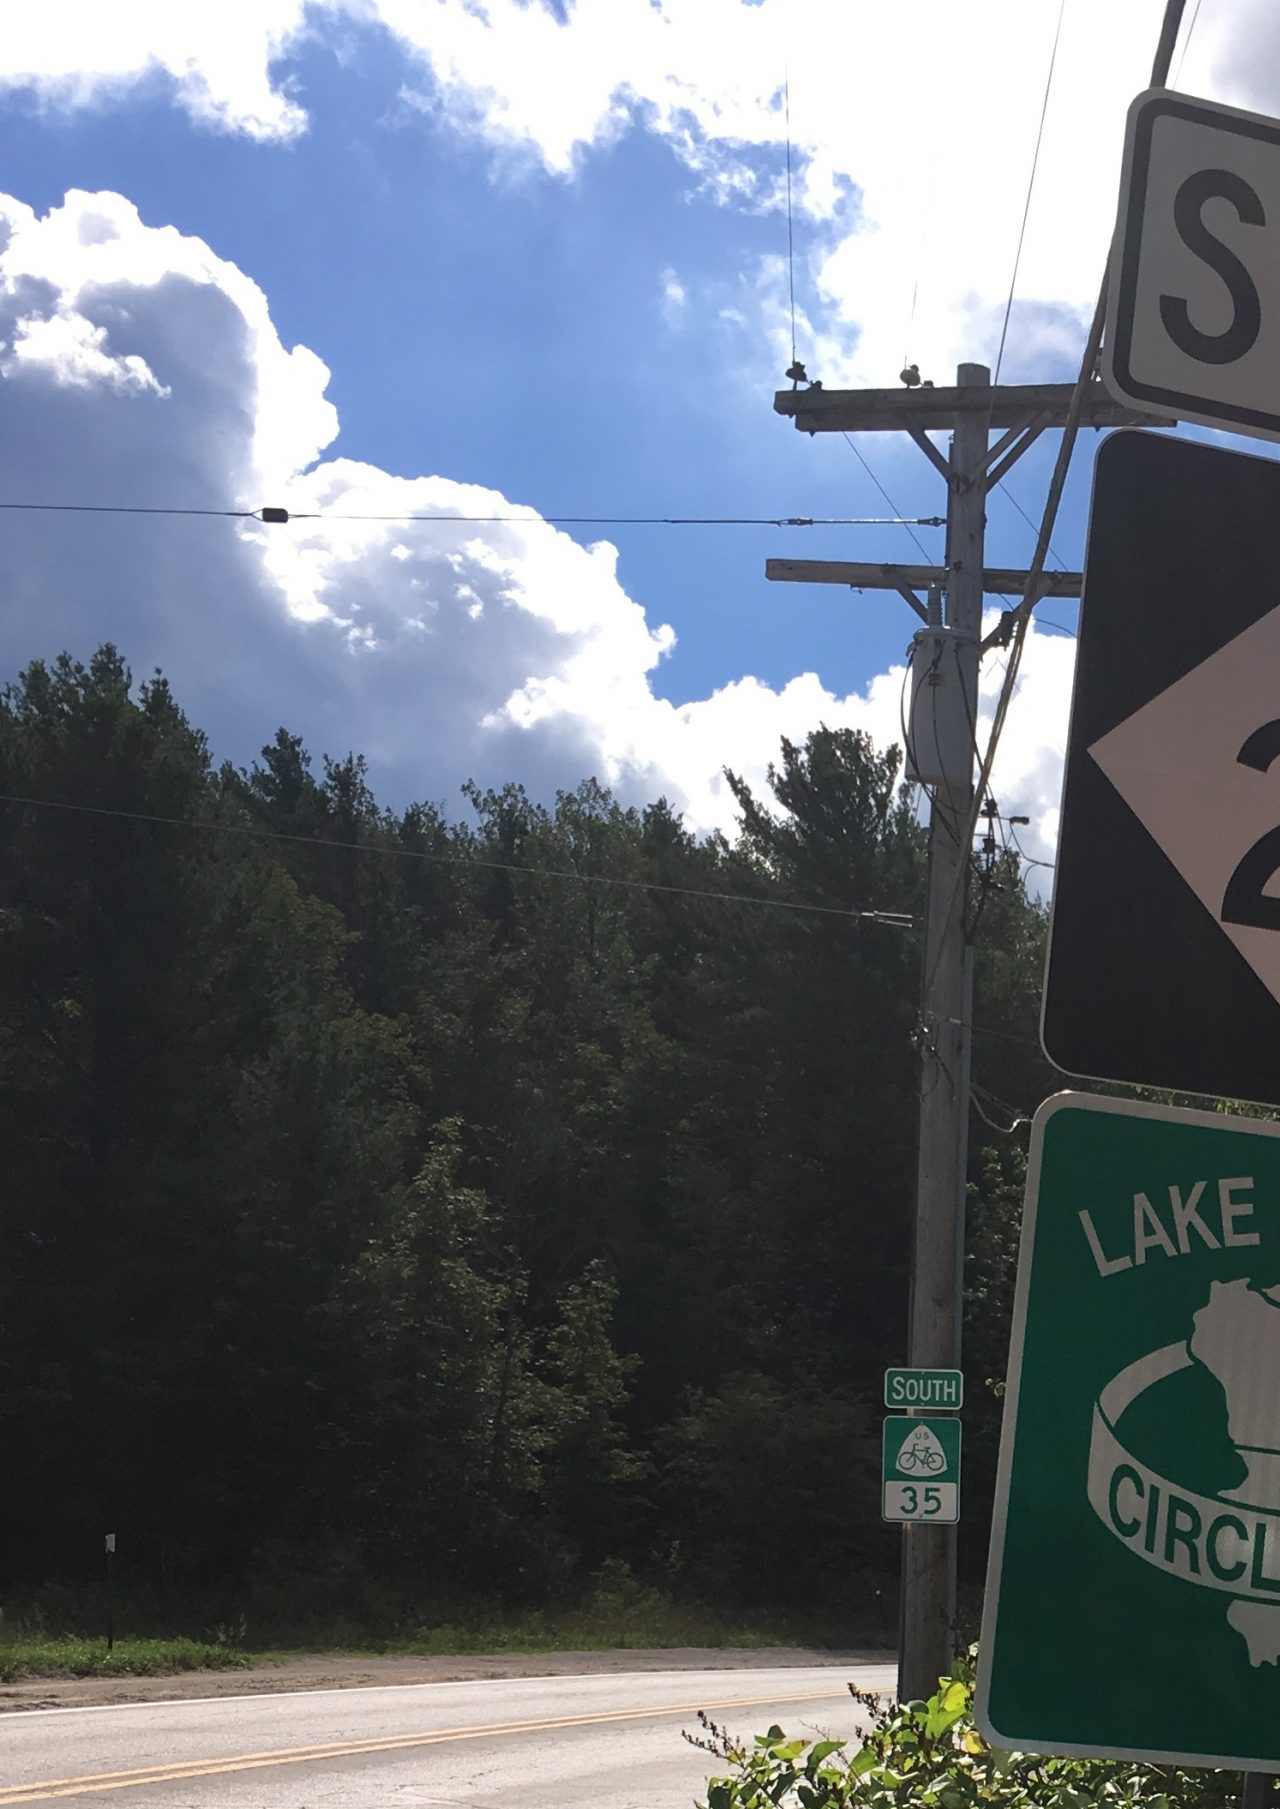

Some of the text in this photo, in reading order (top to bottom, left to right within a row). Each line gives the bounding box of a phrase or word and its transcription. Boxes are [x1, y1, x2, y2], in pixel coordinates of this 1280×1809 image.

[1078, 1176, 1260, 1278] LAKE
[892, 1376, 956, 1402] SOUTH
[915, 1432, 930, 1440] US
[900, 1486, 942, 1515] 35
